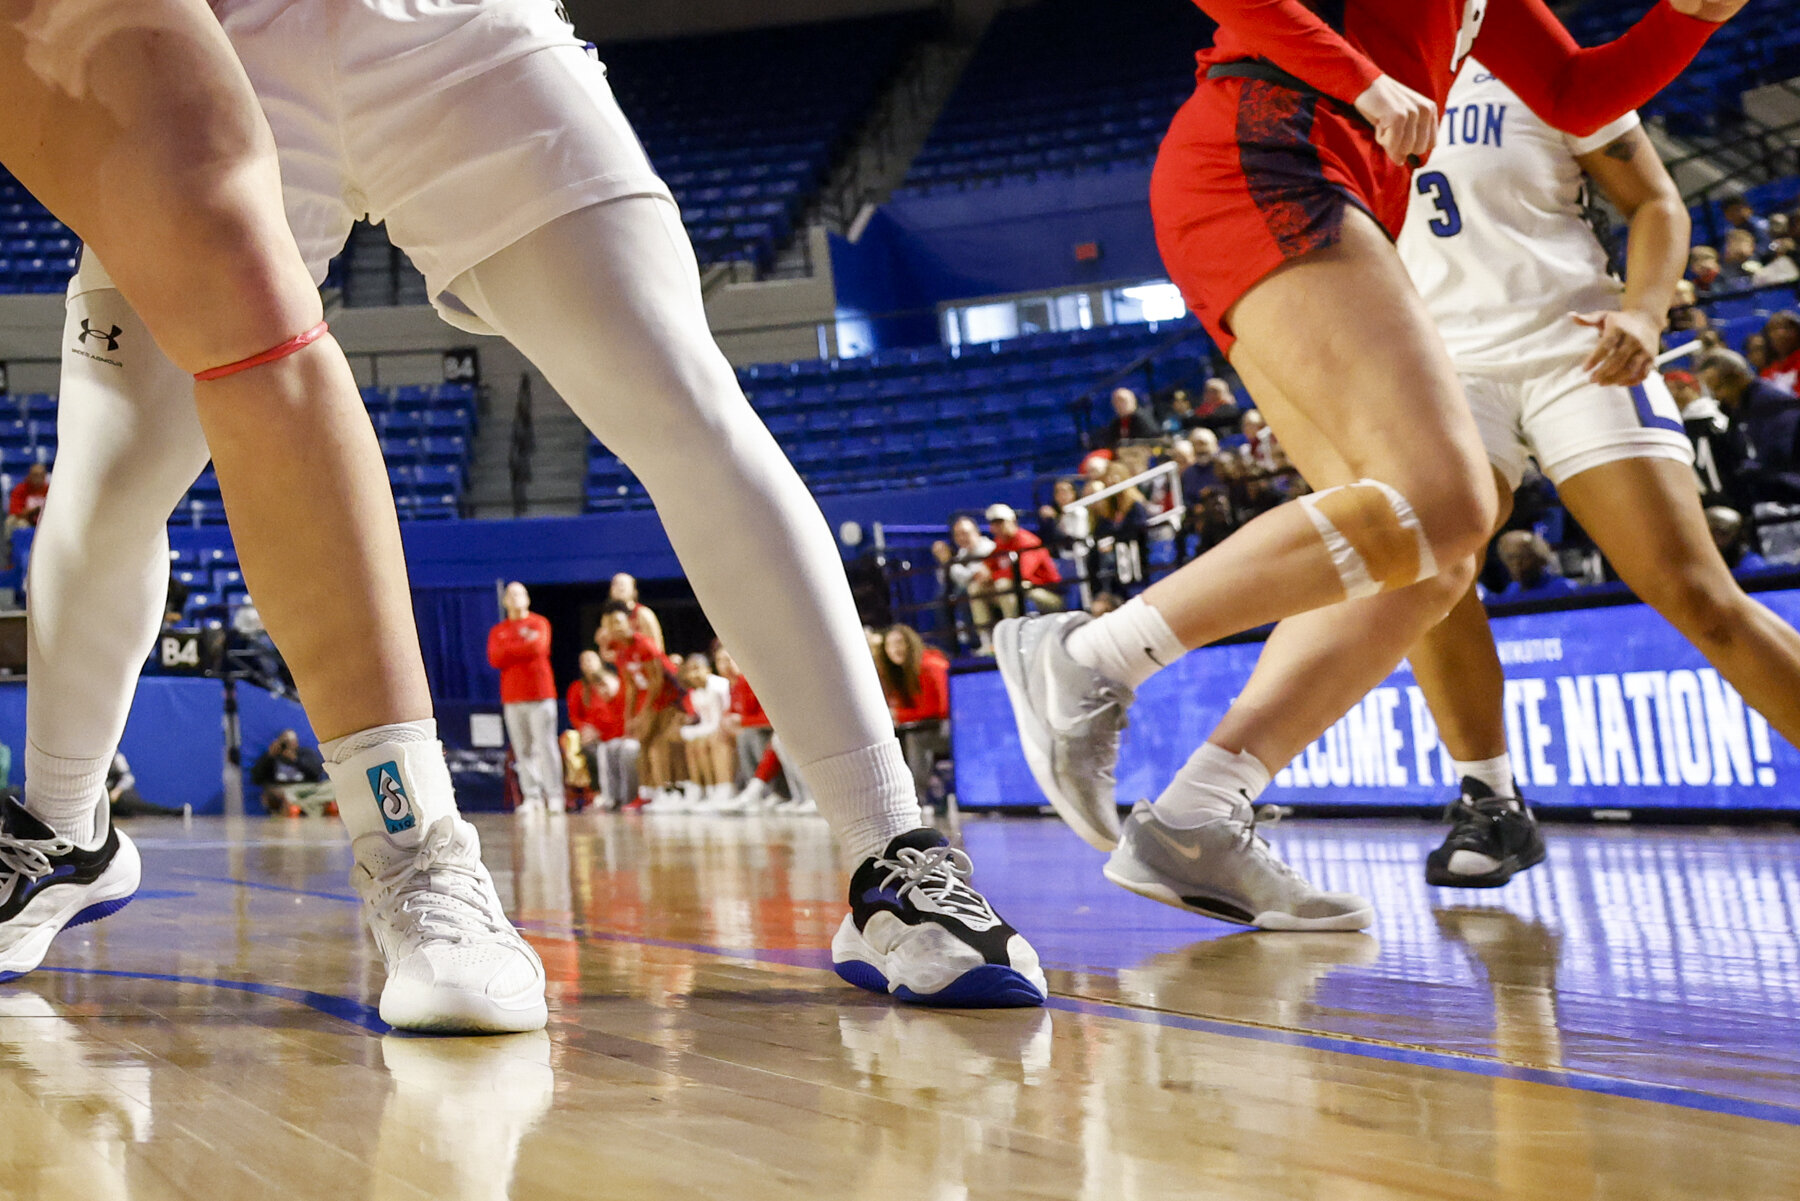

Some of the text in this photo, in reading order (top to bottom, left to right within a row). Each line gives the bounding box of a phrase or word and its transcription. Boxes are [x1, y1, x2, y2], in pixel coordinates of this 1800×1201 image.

[1417, 171, 1462, 238] 3
[162, 636, 199, 667] B4
[1556, 668, 1776, 787] NATION!
